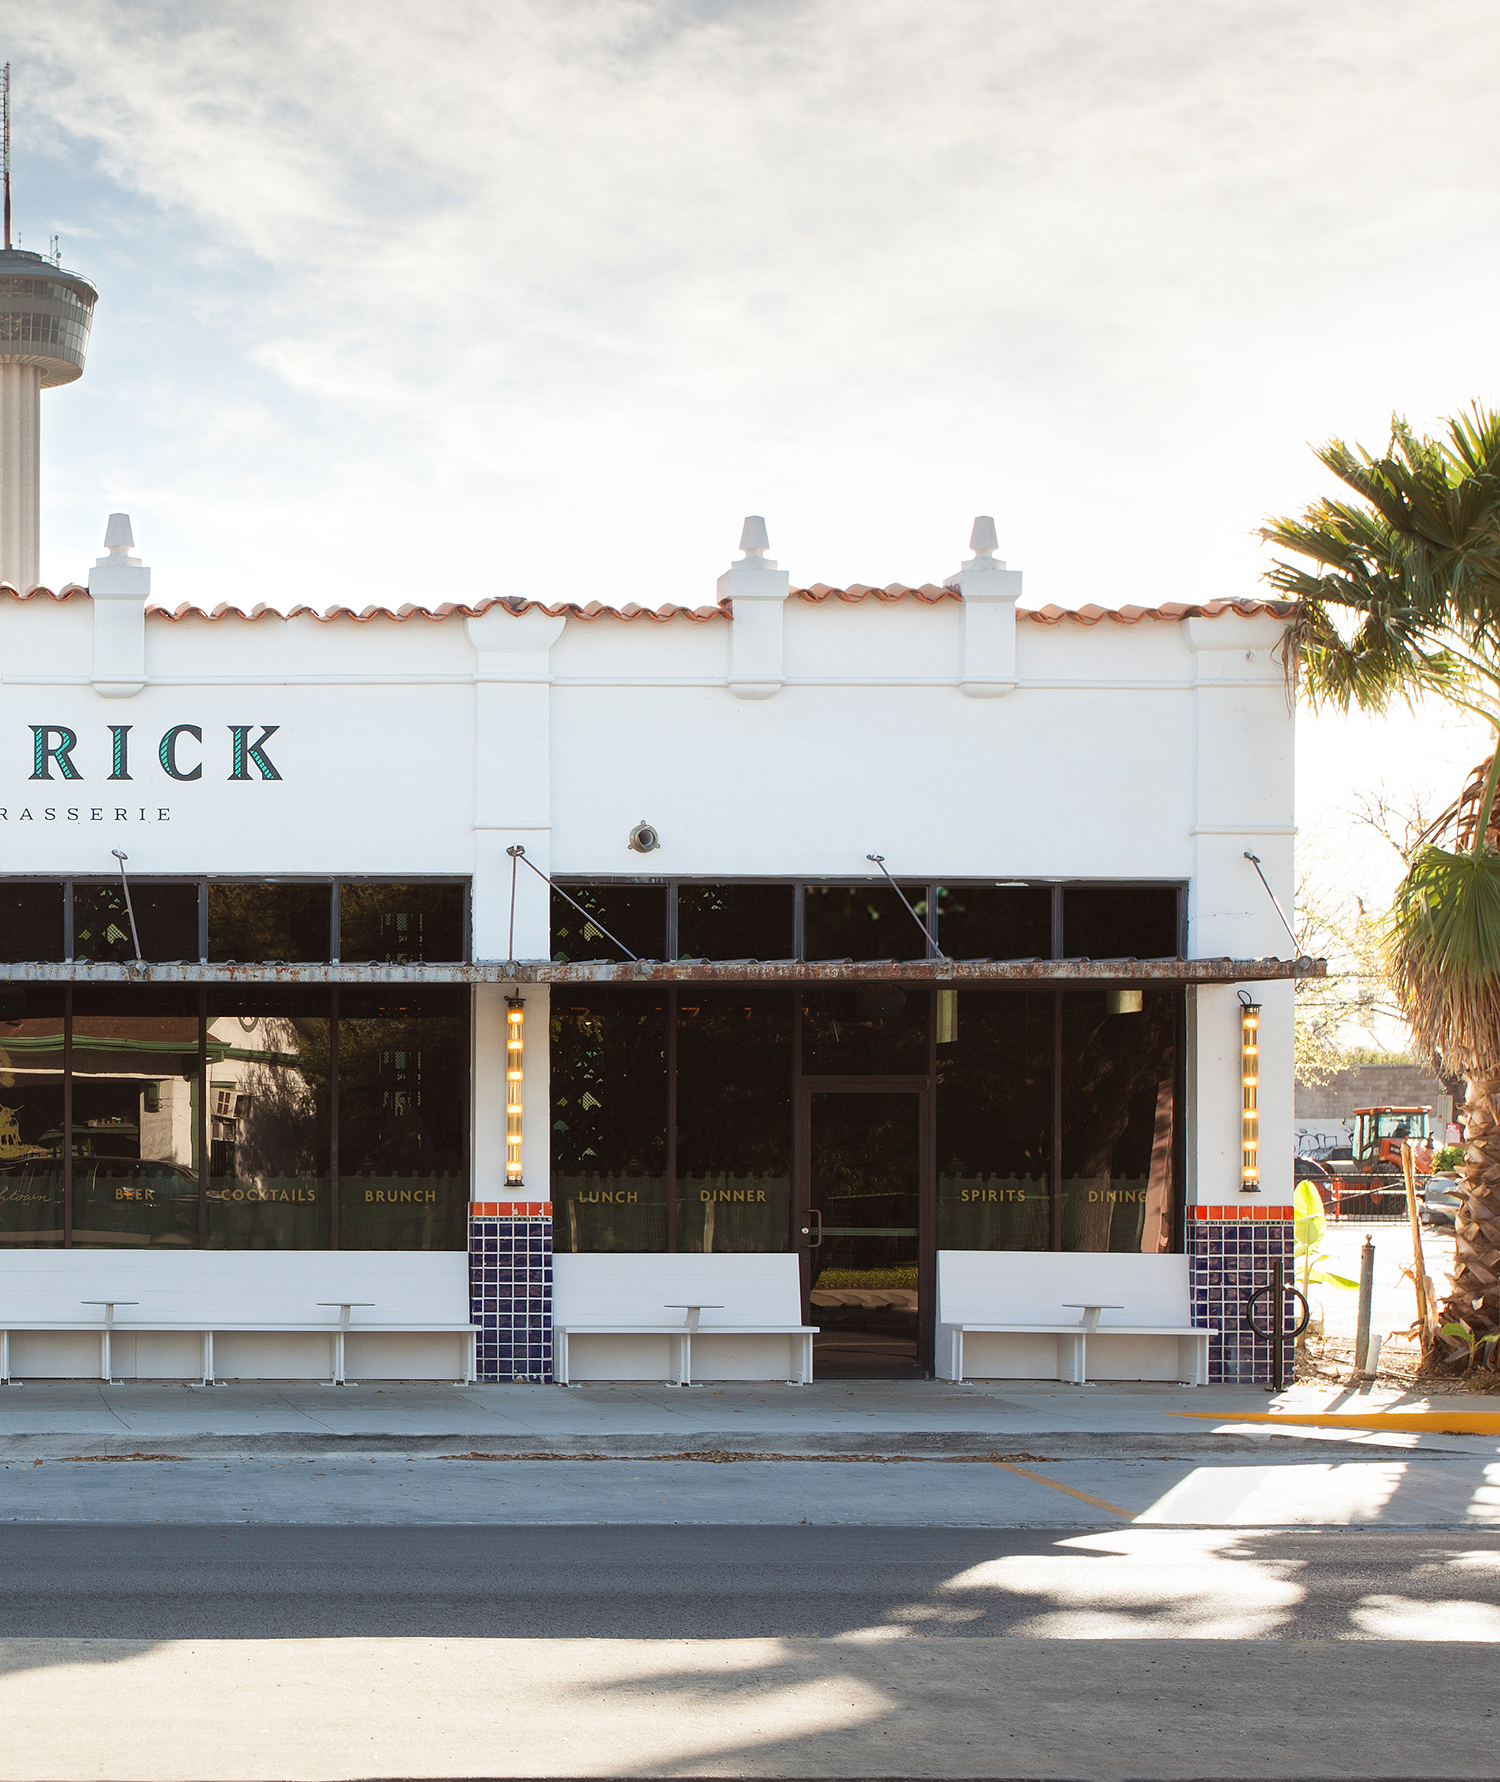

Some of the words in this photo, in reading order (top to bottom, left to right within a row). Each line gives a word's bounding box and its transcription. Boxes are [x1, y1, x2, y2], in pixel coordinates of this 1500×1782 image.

[115, 1188, 155, 1201] BEER
[221, 1188, 316, 1202] COCKTAILS
[365, 1190, 436, 1202] BRUNCH
[579, 1190, 638, 1203] LUNCH
[700, 1190, 766, 1202] DINNER
[961, 1189, 1026, 1202] SPIRITS
[1088, 1190, 1148, 1203] DINING
